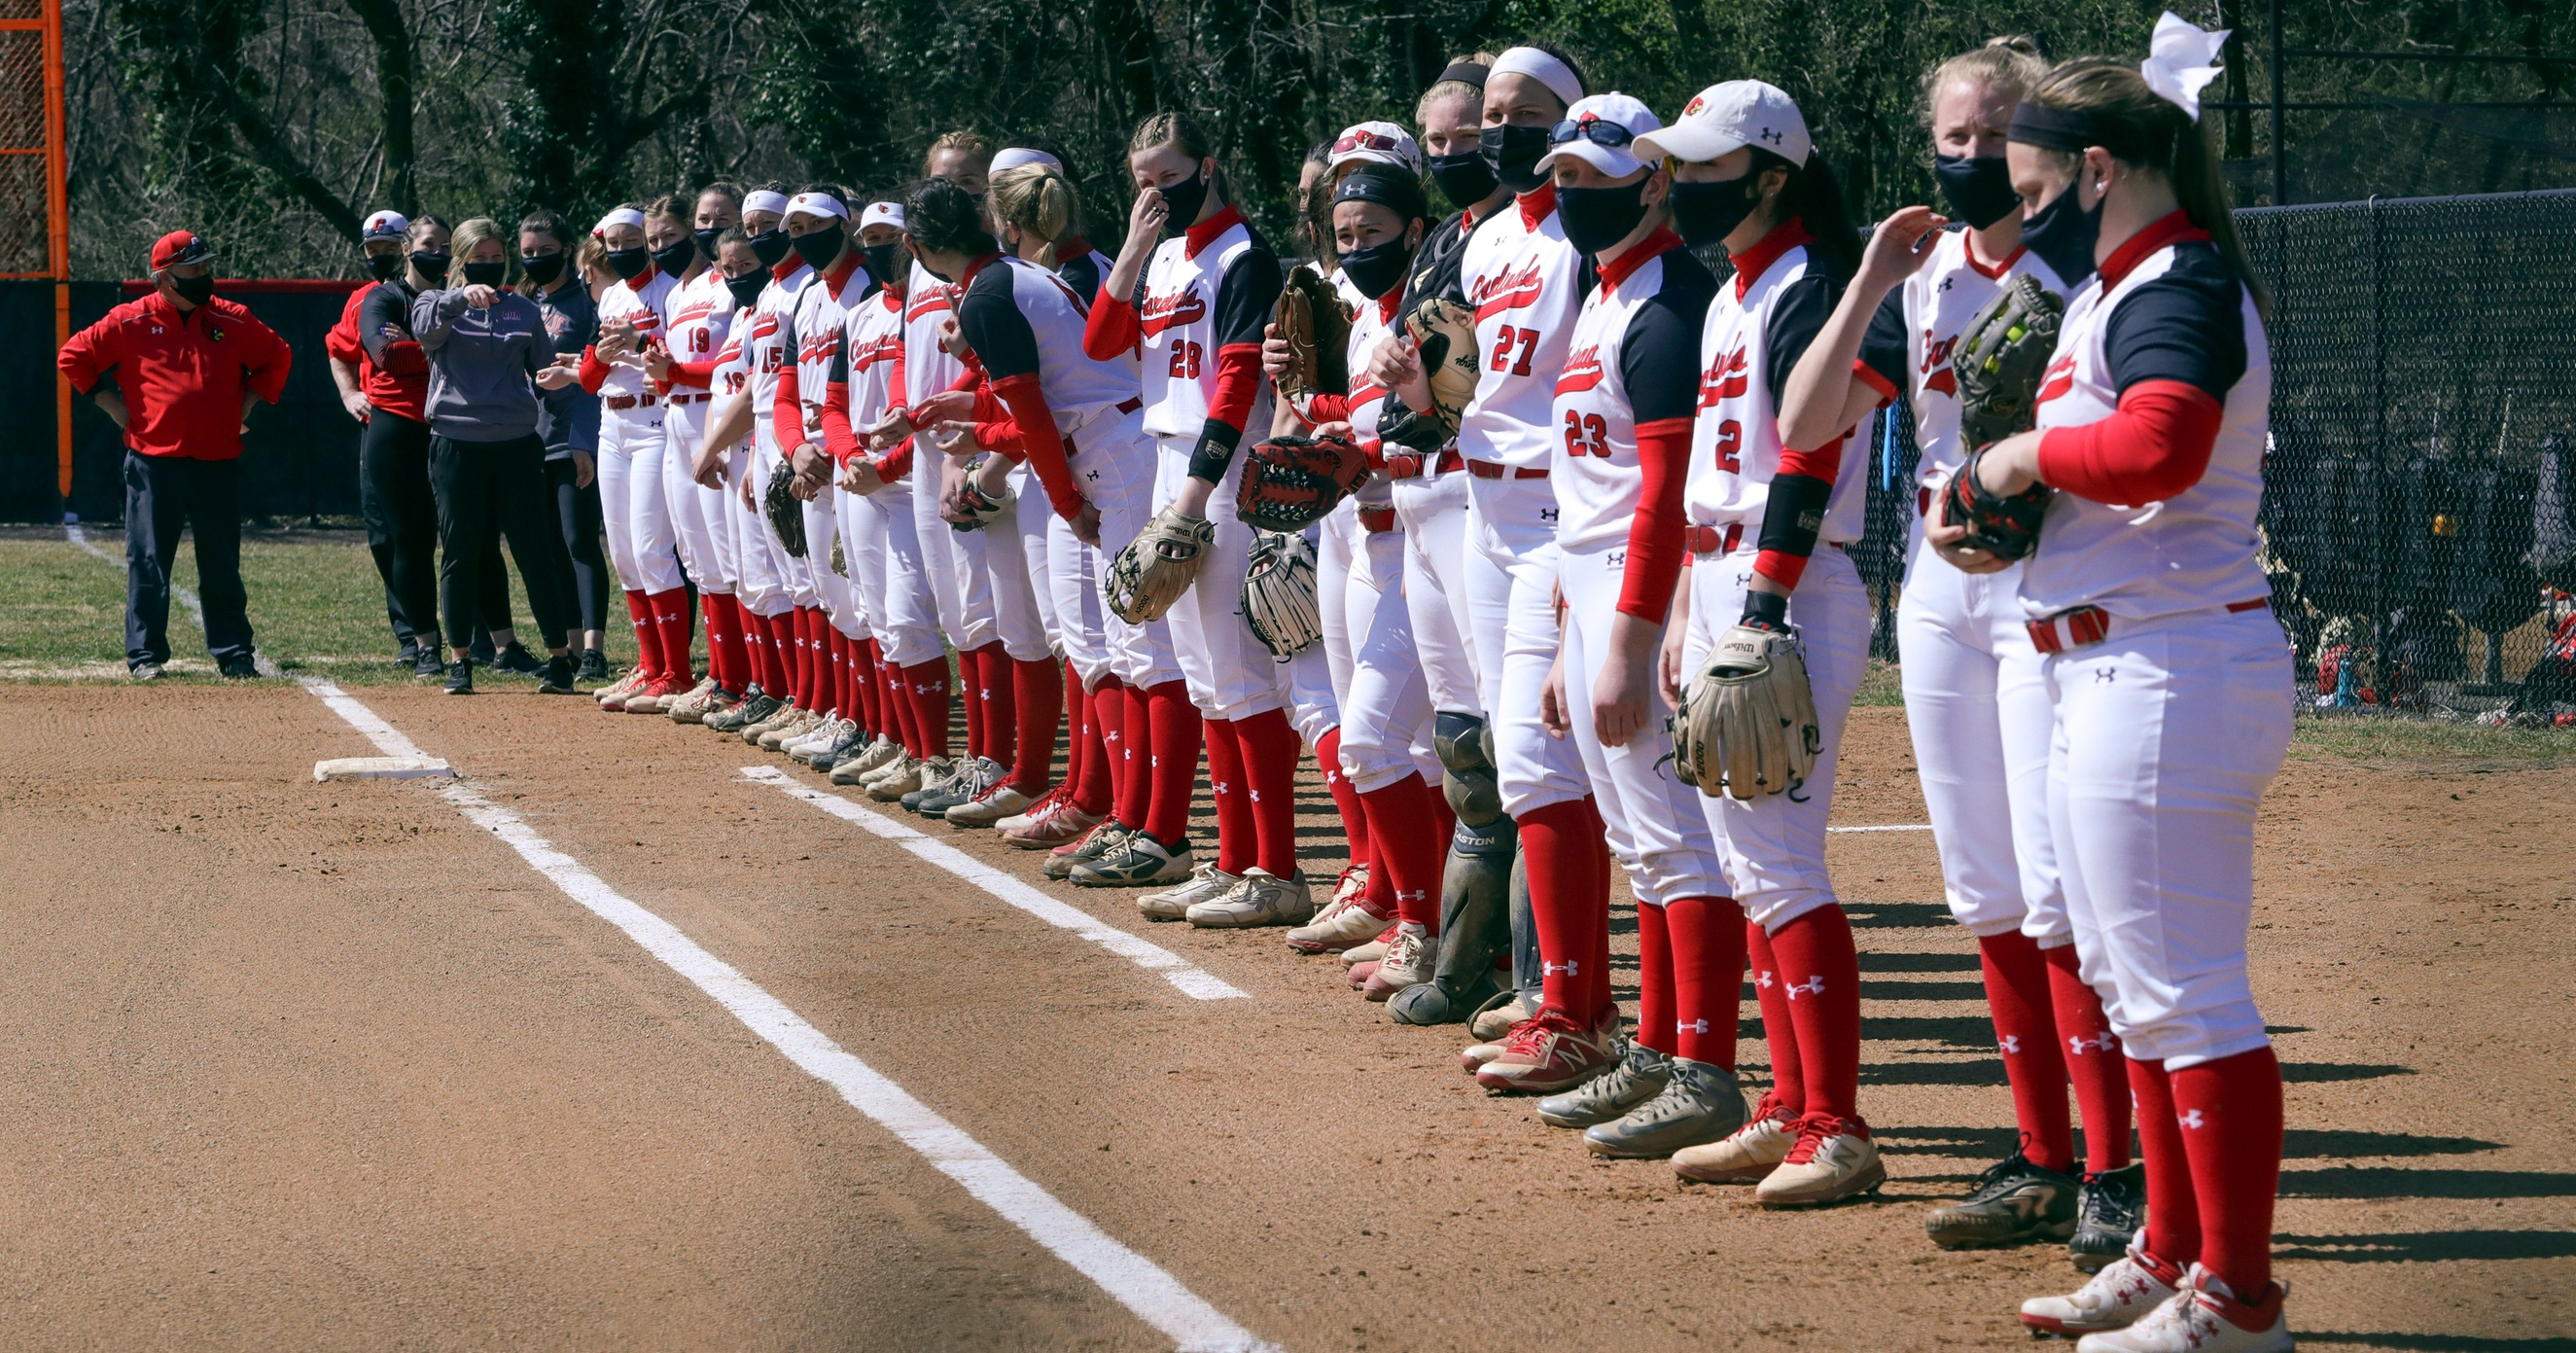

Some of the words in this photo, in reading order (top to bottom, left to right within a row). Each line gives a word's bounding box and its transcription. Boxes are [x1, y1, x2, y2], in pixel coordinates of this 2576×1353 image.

[688, 327, 710, 353] 19
[1491, 324, 1540, 376] 27
[761, 346, 783, 374] 15
[1169, 338, 1202, 379] 28
[724, 372, 745, 395] 16
[1565, 409, 1611, 458] 23
[1715, 419, 1742, 475] 2
[1166, 524, 1190, 537] Wilson
[1135, 594, 1149, 614] A2000
[1256, 618, 1276, 642] A2000
[1723, 642, 1754, 653] Wilson
[1696, 740, 1707, 779] A2000
[1456, 833, 1495, 846] ASTON
